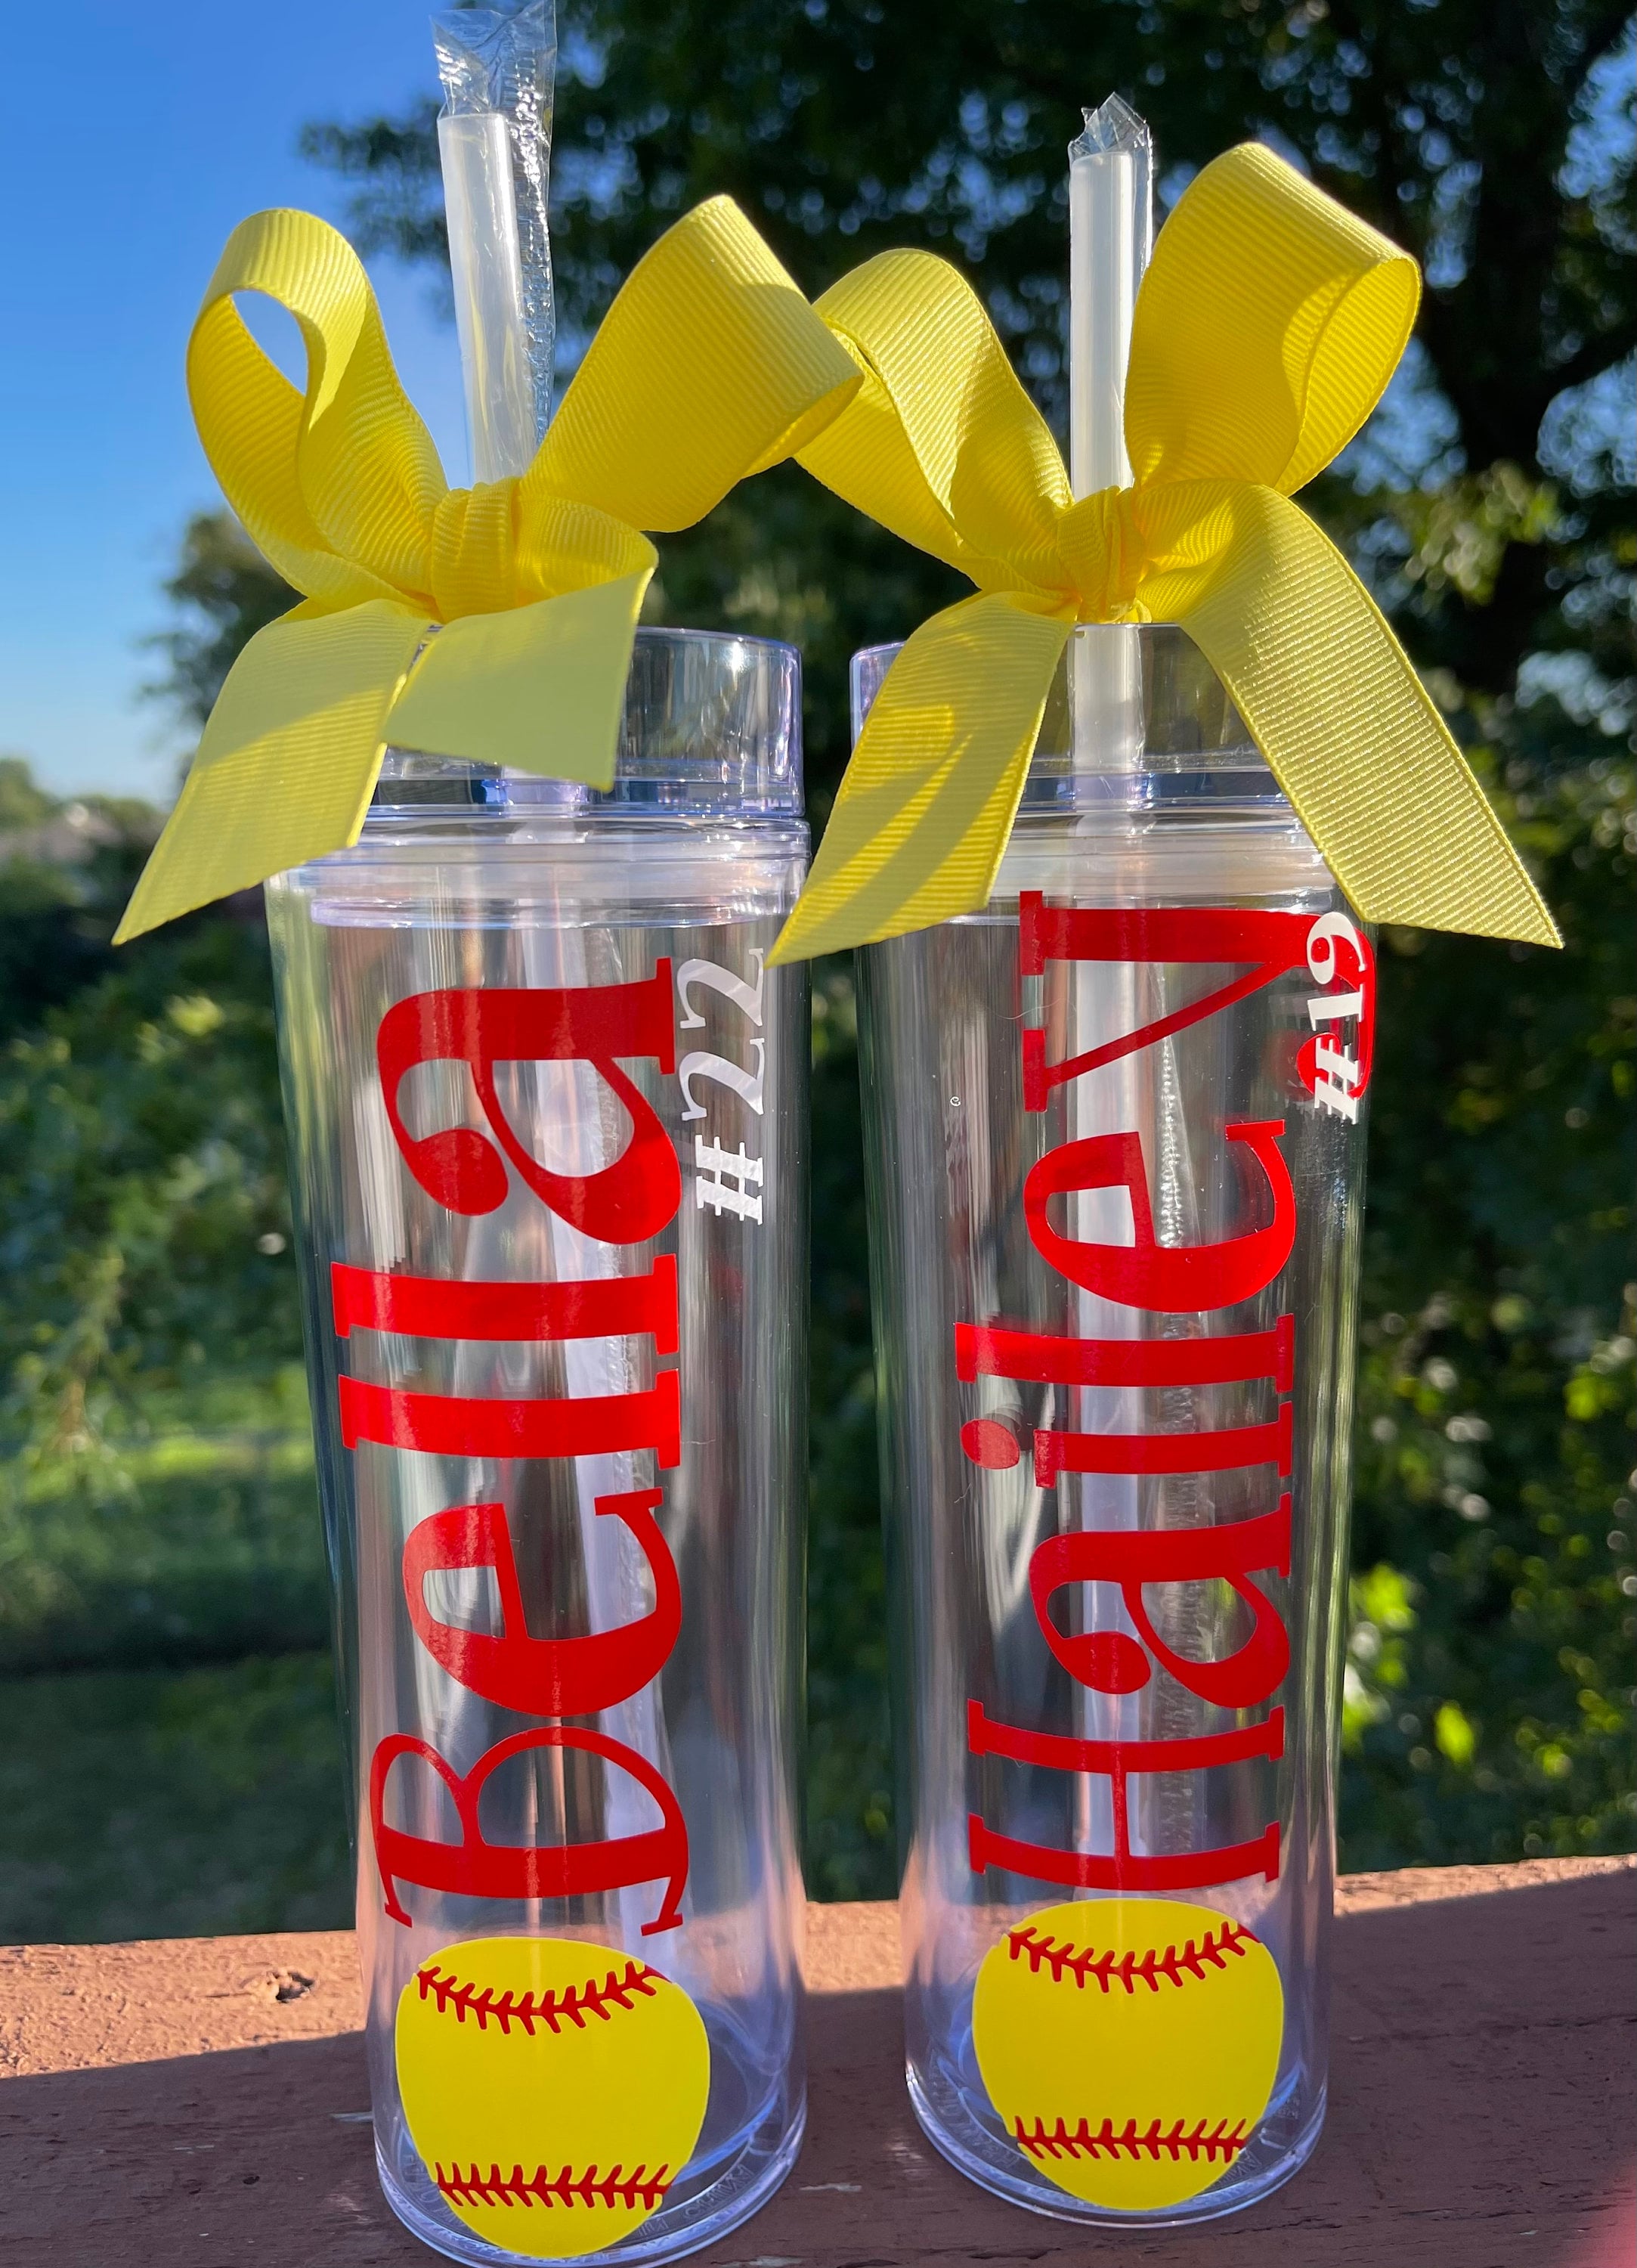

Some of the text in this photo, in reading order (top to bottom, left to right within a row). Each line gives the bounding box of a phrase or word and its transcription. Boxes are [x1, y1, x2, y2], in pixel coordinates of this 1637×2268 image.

[676, 947, 766, 1225] #22
[1306, 911, 1365, 1126] #19
[330, 956, 689, 1936] Bella
[954, 891, 1377, 1892] Hailey
